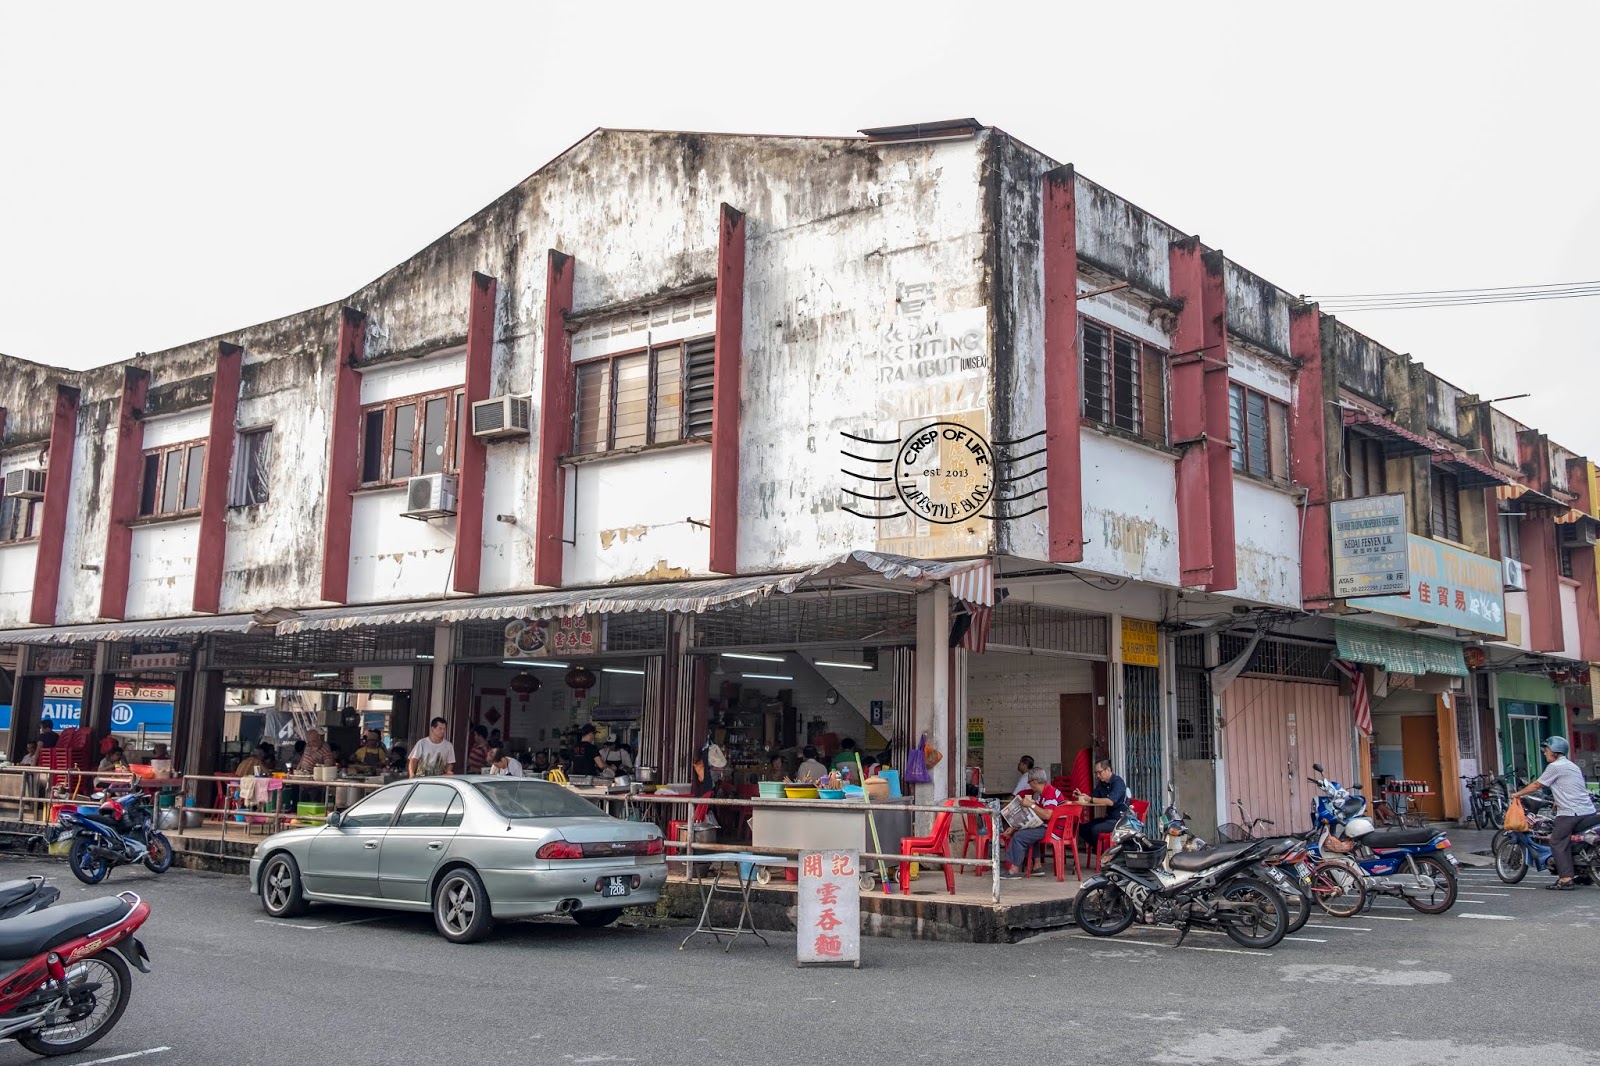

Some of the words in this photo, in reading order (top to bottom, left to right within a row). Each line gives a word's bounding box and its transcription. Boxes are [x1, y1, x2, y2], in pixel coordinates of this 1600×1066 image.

[1344, 540, 1360, 549] KEDAI
[1361, 537, 1381, 548] FESYEN
[1338, 577, 1354, 585] ATAS
[1443, 550, 1499, 596] TRADING
[1401, 581, 1467, 612] 佳貿易
[50, 686, 70, 694] AIR
[803, 853, 855, 879] 開記
[609, 885, 625, 895] 7208
[815, 882, 843, 957] 雲吞麵
